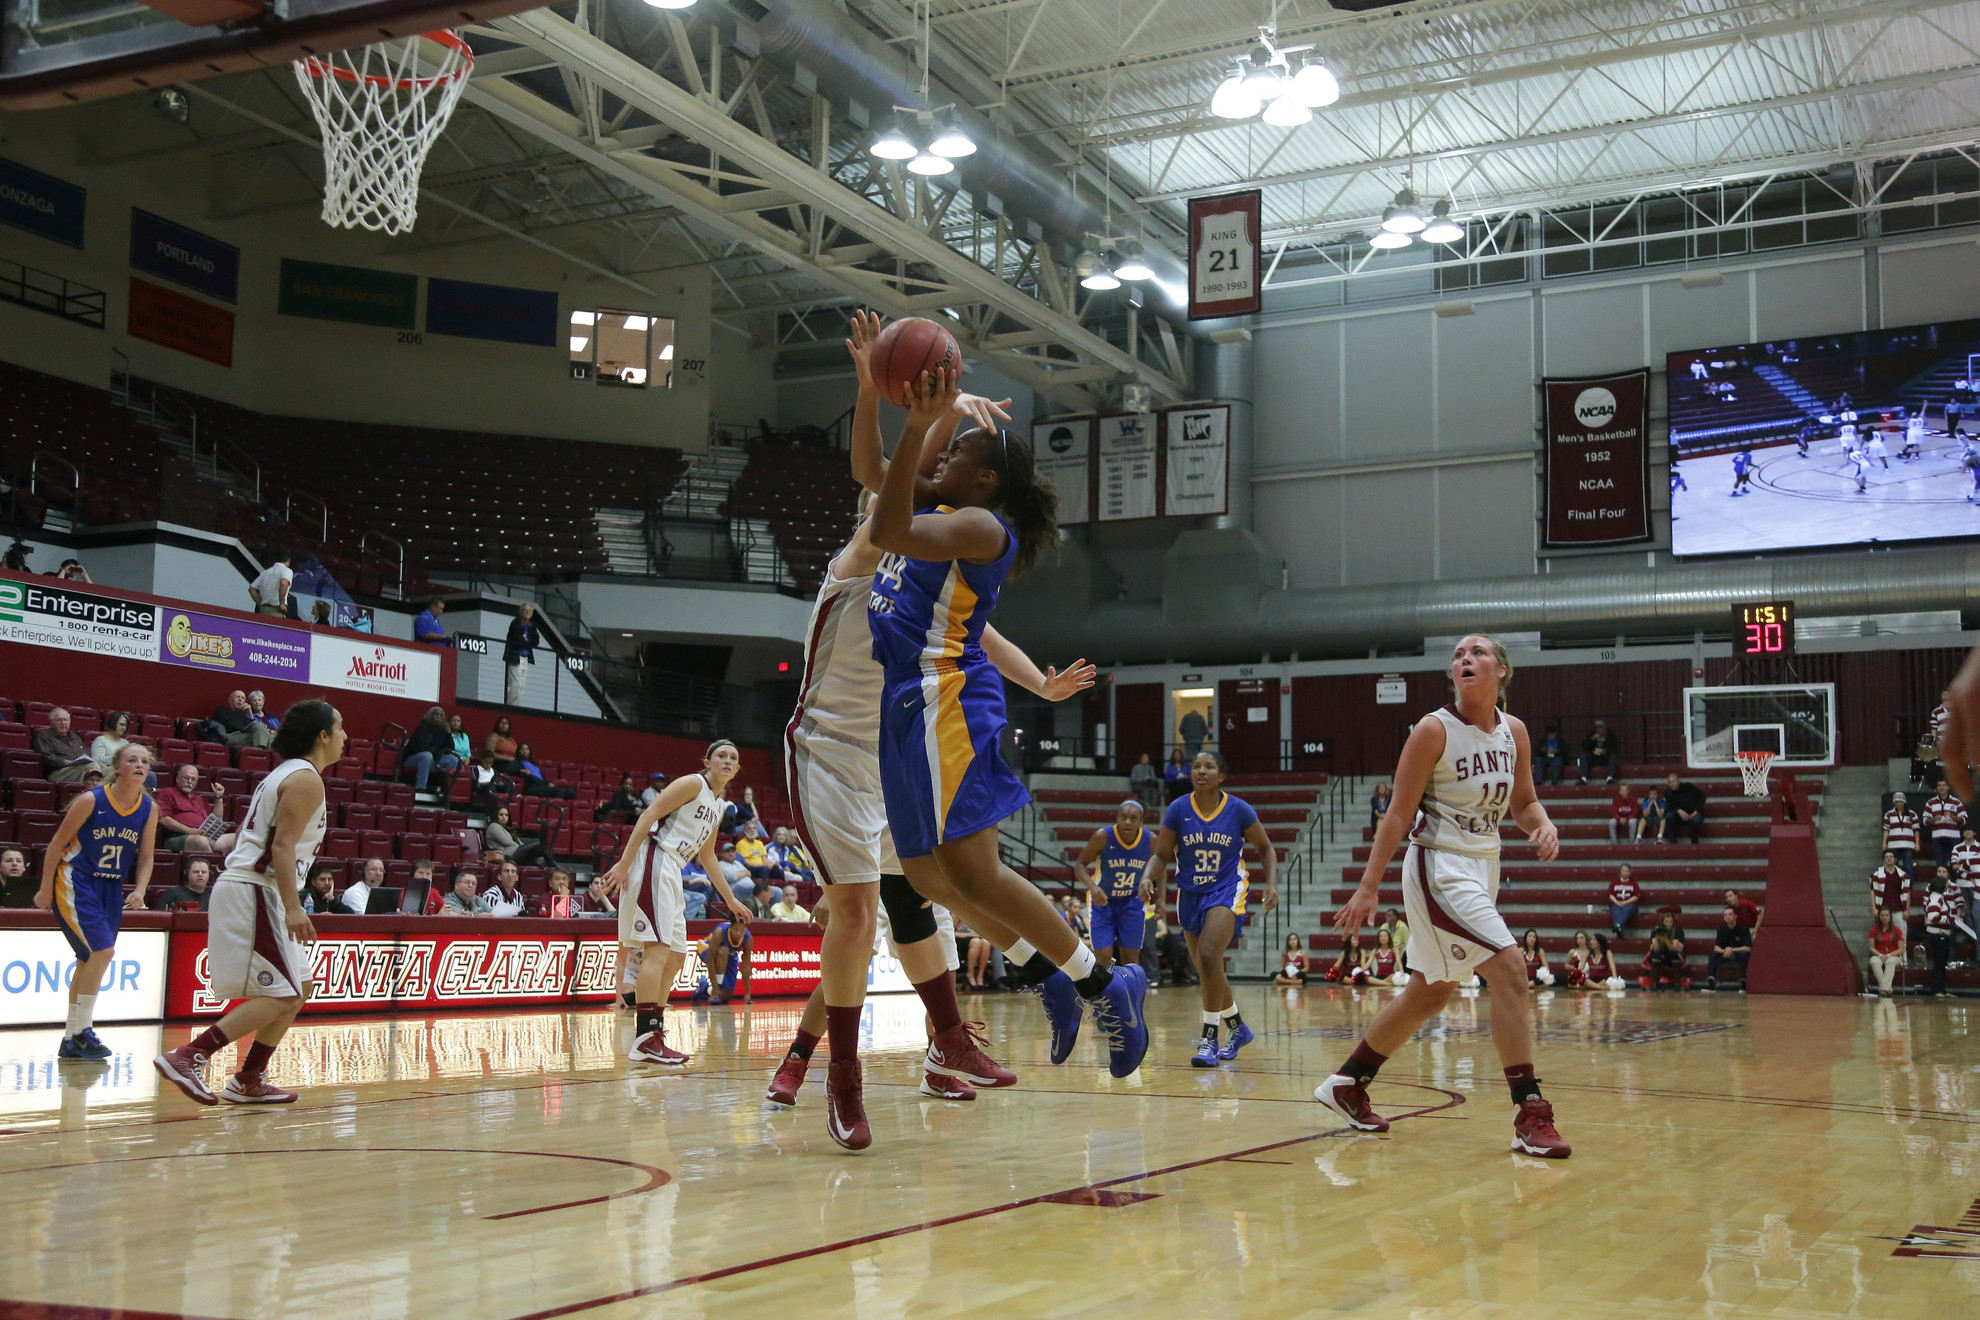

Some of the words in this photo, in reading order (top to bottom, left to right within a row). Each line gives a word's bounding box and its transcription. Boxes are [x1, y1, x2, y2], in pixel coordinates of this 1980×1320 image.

[1211, 230, 1237, 241] KING
[156, 241, 216, 274] PORTLAND
[1209, 248, 1239, 272] 21
[293, 282, 321, 297] SAN
[326, 286, 404, 306] FRANCISCO
[1202, 281, 1248, 294] 1990-1993
[397, 332, 423, 345] 206
[681, 358, 705, 373] 207
[1579, 405, 1615, 418] NCAA
[1557, 434, 1584, 444] Men's
[1587, 428, 1636, 443] Basketball
[1584, 451, 1611, 462] 1952
[1579, 478, 1614, 490] NCAA
[1567, 509, 1596, 520] Final
[1599, 508, 1626, 519] Four
[27, 589, 153, 626] Enterprise
[868, 590, 896, 614] TATE
[1744, 606, 1787, 623] 11:51
[67, 621, 88, 631] 800
[93, 624, 152, 641] rent-a-car
[1745, 623, 1783, 653] 30
[11, 627, 65, 645] Enterprise.
[68, 635, 92, 648] We'll
[94, 640, 116, 653] pick
[118, 645, 137, 656] you
[467, 638, 486, 654] 102
[249, 651, 297, 668] 408-244-2034
[567, 656, 583, 670] 103
[1600, 651, 1616, 660] 105
[346, 656, 407, 681] Marriott
[1040, 740, 1060, 750] 104
[1303, 742, 1324, 754] 104
[1477, 782, 1508, 807] 10
[694, 805, 718, 828] SANT
[1454, 810, 1499, 834] CLAR
[92, 827, 116, 840] SAN
[1182, 832, 1204, 847] SAN
[1207, 832, 1233, 847] JOSE
[98, 844, 124, 870] 21
[1108, 858, 1126, 869] SAN
[1127, 859, 1146, 869] JOSE
[1194, 849, 1222, 873] 33
[1113, 872, 1136, 889] 34
[1193, 875, 1217, 885] STATE
[1111, 889, 1133, 897] STATE
[769, 951, 799, 963] Athletic
[801, 951, 821, 963] Webs
[433, 941, 575, 1000] CLARA
